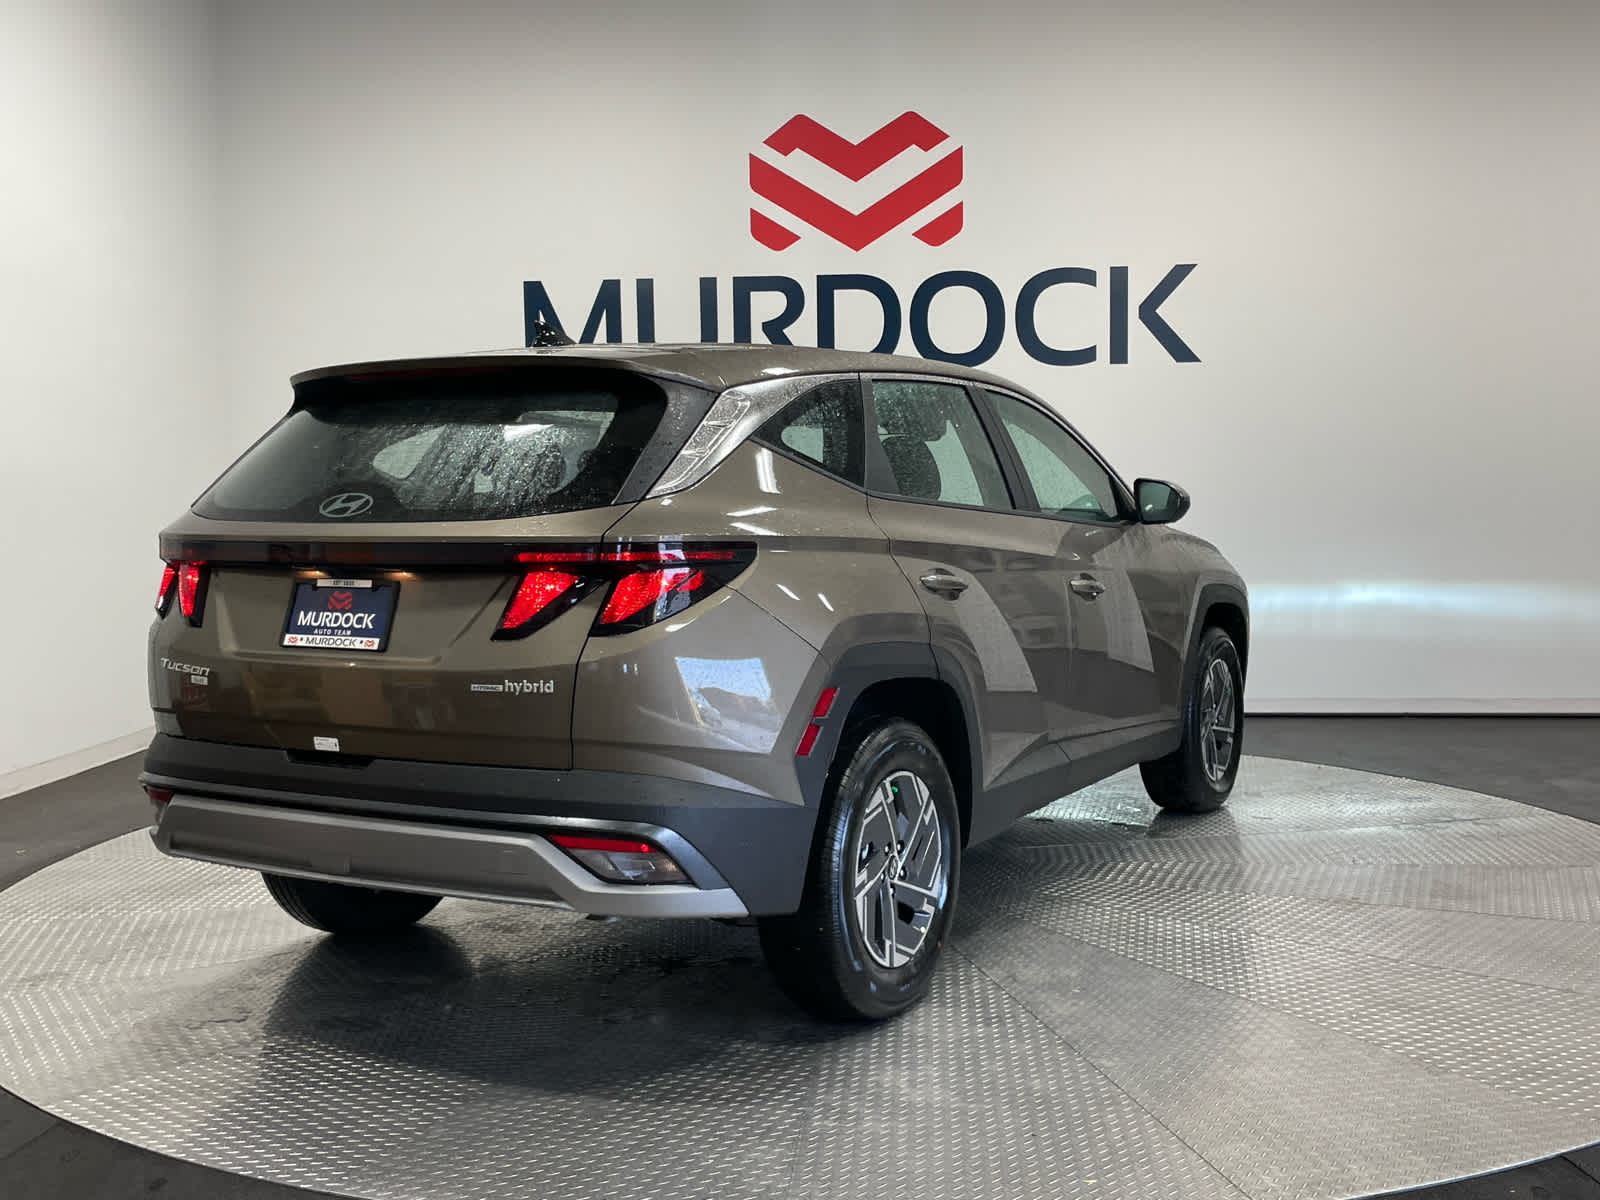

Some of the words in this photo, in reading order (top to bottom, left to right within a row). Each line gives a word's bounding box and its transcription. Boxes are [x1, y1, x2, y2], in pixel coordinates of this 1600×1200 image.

[523, 263, 1202, 367] MURDOCK
[297, 610, 376, 630] MURDOCK
[305, 636, 358, 647] MURDOCK
[504, 679, 554, 696] hybrid
